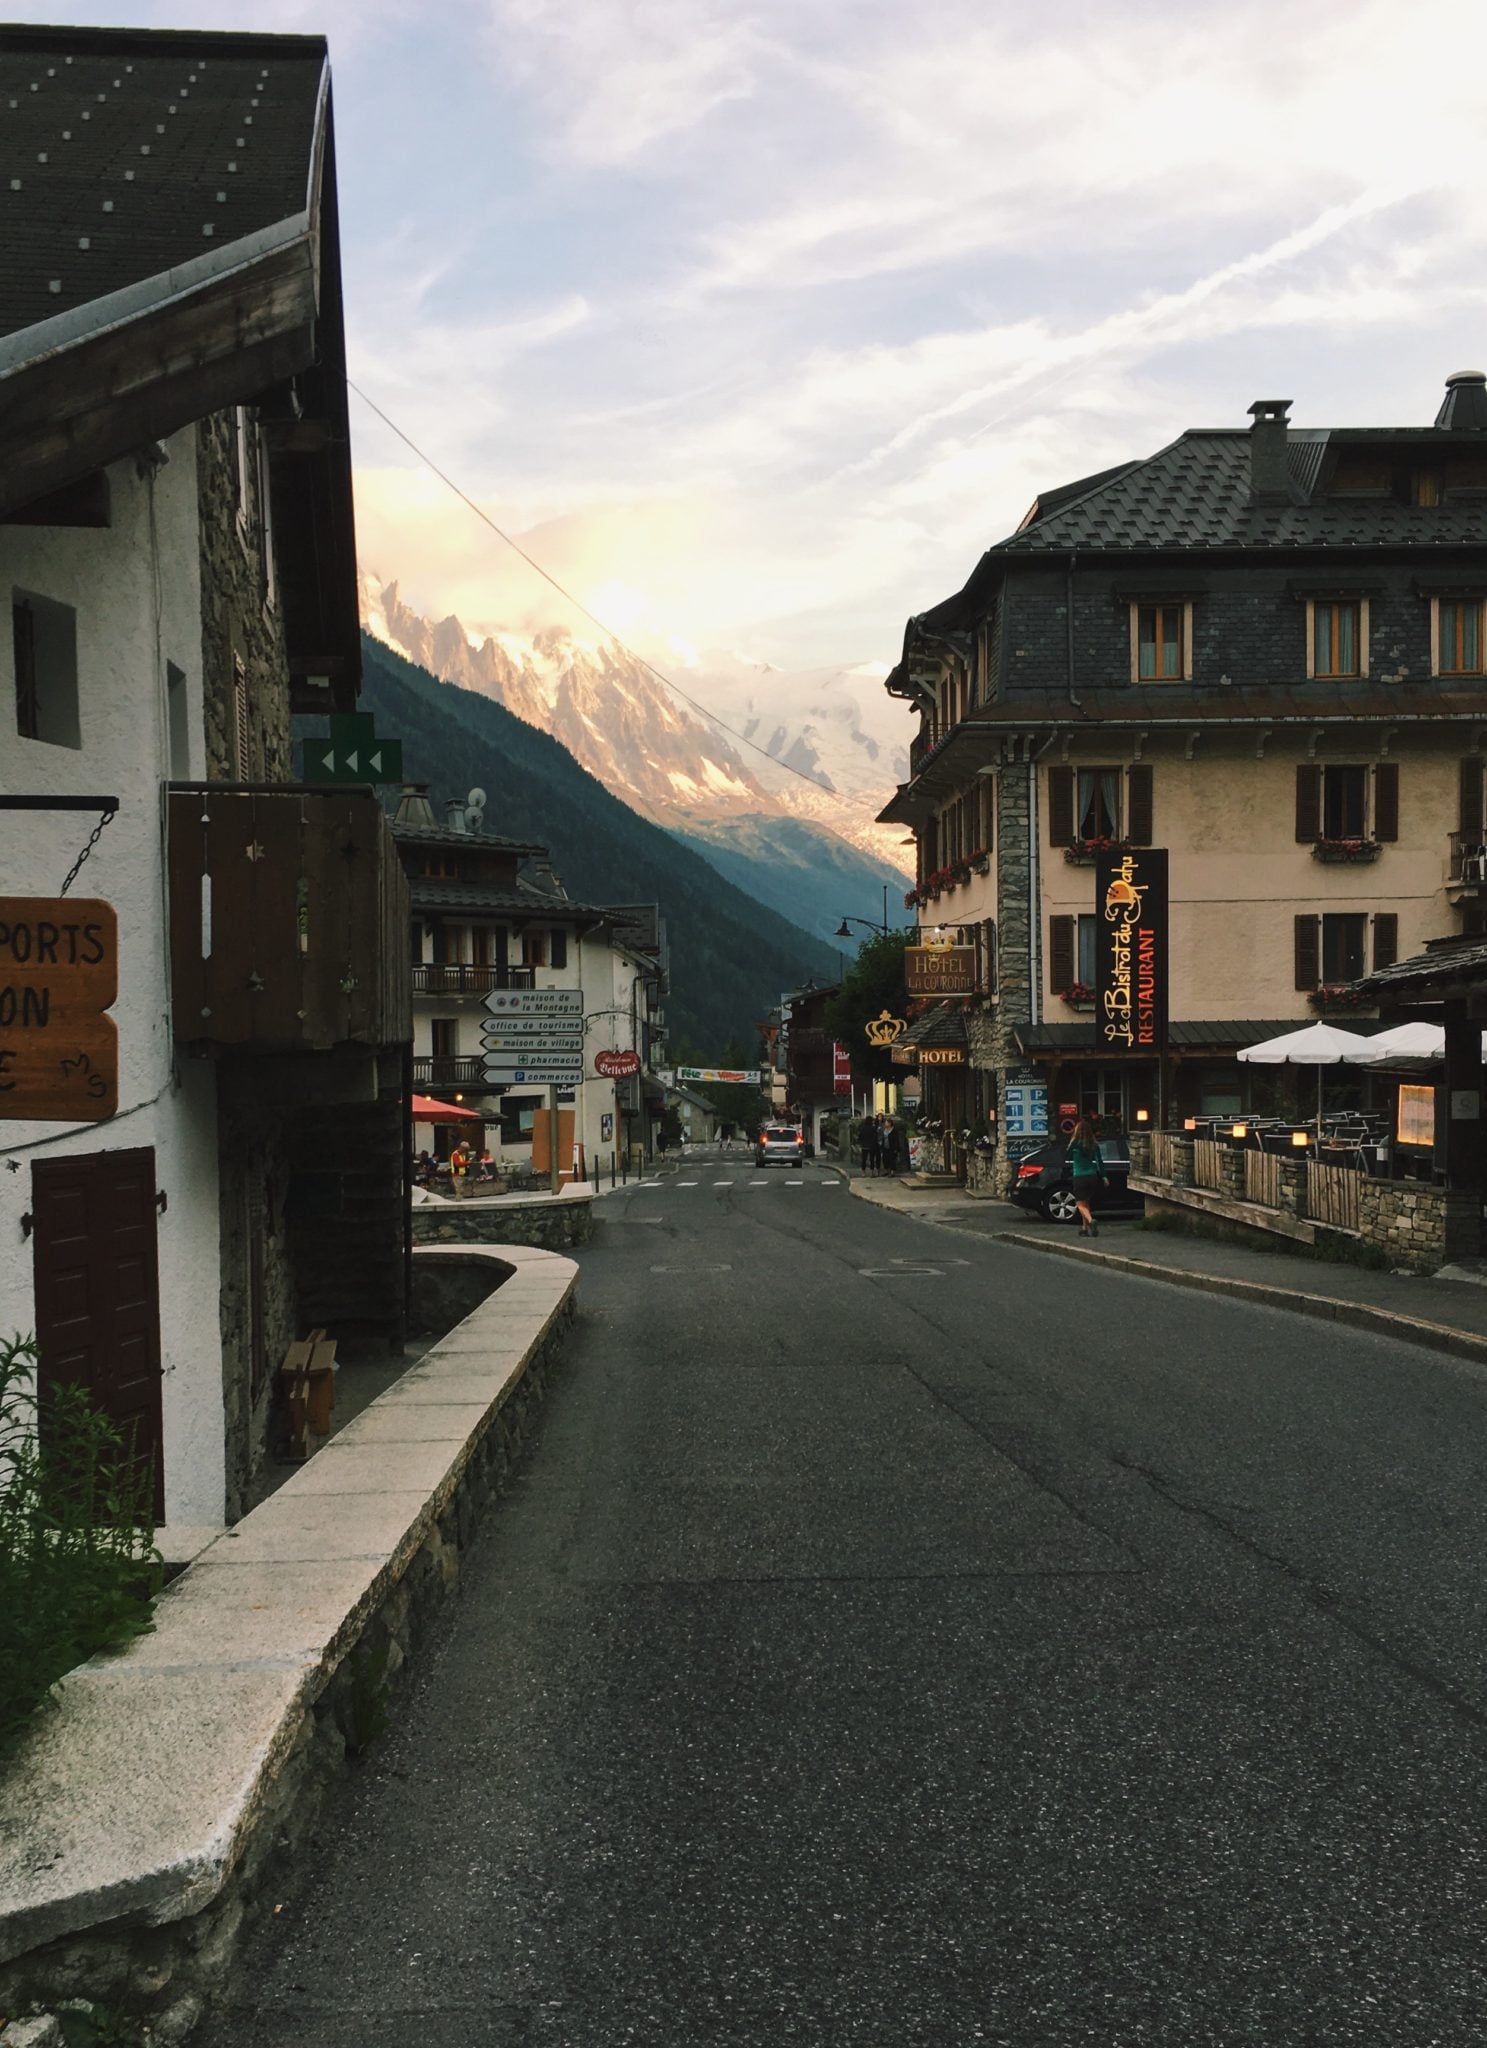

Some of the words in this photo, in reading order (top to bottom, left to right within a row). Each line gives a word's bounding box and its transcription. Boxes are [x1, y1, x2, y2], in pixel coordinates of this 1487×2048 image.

[1105, 856, 1149, 924] Dahu
[1112, 923, 1132, 944] du
[1104, 935, 1132, 1019] Bistrot
[1139, 927, 1155, 1043] RESTAURANT
[558, 994, 570, 1002] de
[522, 1004, 531, 1012] la
[535, 1004, 580, 1013] Montagne
[490, 1022, 518, 1030] office
[523, 1022, 534, 1030] de
[539, 1022, 580, 1030] tourisme
[1104, 1019, 1134, 1047] Le
[537, 1039, 547, 1047] de
[551, 1039, 580, 1048] village
[530, 1056, 580, 1065] pharmacie
[919, 1050, 965, 1063] HOTEL
[600, 1063, 637, 1075] Bellevue
